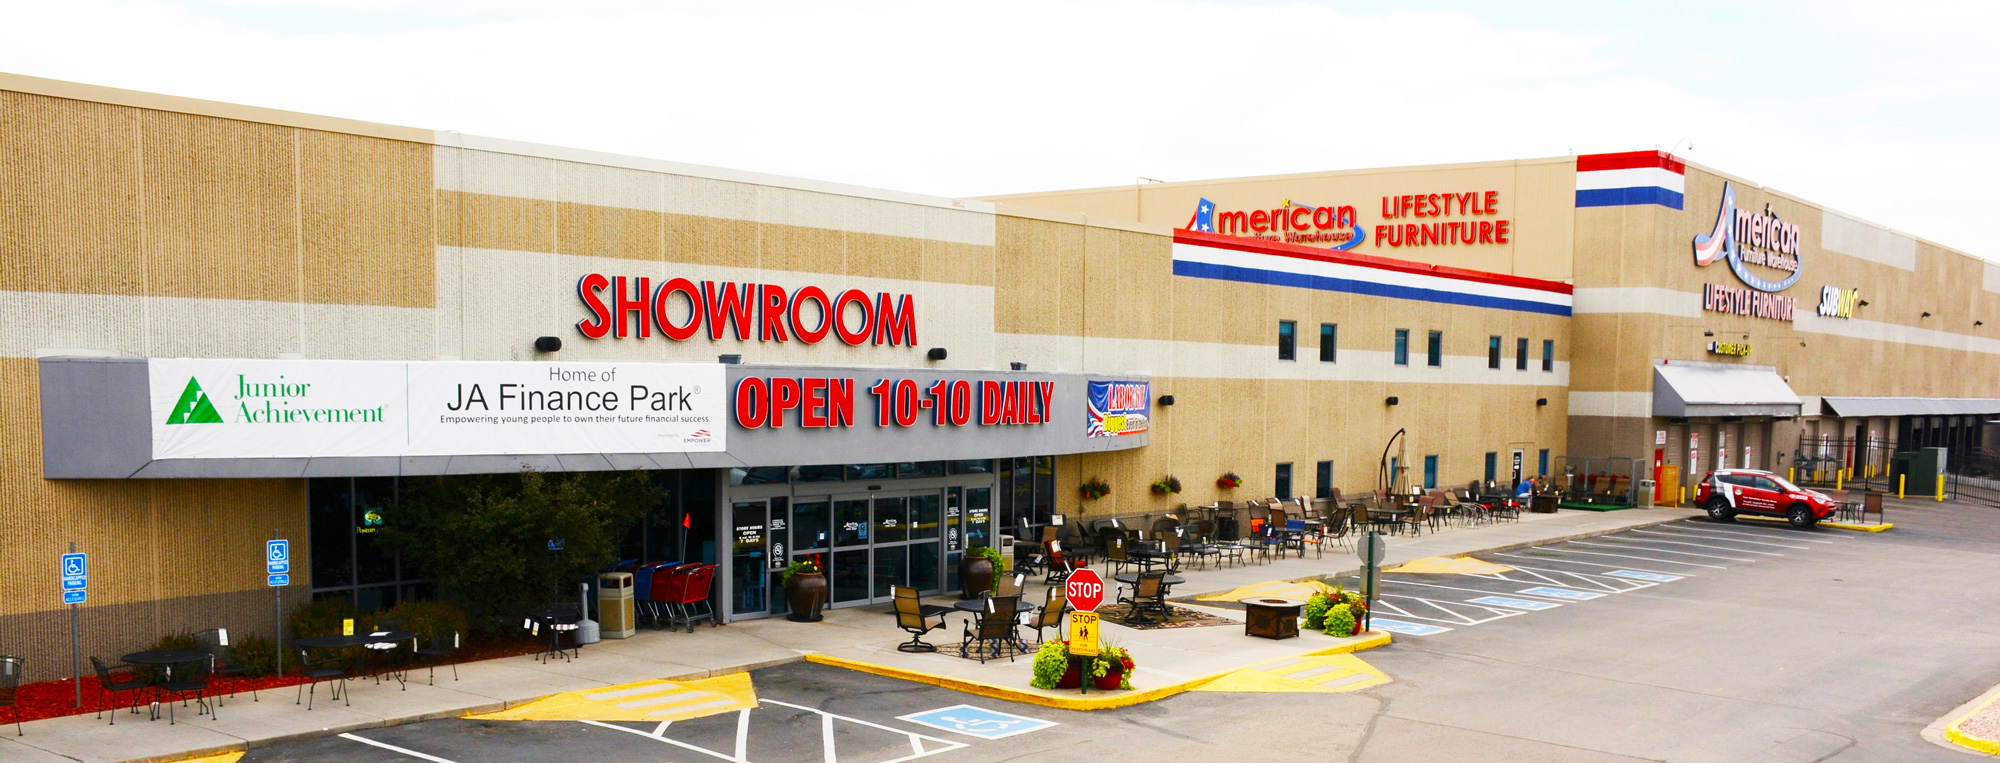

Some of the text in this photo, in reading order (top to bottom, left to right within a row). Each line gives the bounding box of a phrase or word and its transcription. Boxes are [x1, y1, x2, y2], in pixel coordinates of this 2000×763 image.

[1382, 191, 1499, 219] LIFESTYLE
[1375, 220, 1510, 248] FURNITURE
[1740, 244, 1798, 271] Furniture Warehouse
[575, 272, 918, 347] SHOWROOM
[1703, 283, 1798, 321] LIFESTYLE FURNITURE
[1818, 285, 1858, 318] SUBWAY
[234, 374, 311, 400] Junior
[549, 367, 617, 382] Home of
[447, 383, 489, 411] JA
[499, 384, 619, 411] Finance
[735, 376, 1056, 429] OPEN 10-10 DAILY
[1108, 384, 1135, 411] LABOR
[234, 401, 385, 423] Achievement
[440, 415, 499, 424] Empowering
[501, 416, 529, 424] young
[531, 415, 561, 424] people
[595, 415, 616, 423] their
[618, 415, 643, 423] future
[645, 415, 679, 423] financial
[1103, 412, 1127, 433] Biggest
[1068, 581, 1101, 598] STOP
[1072, 614, 1097, 624] STOP
